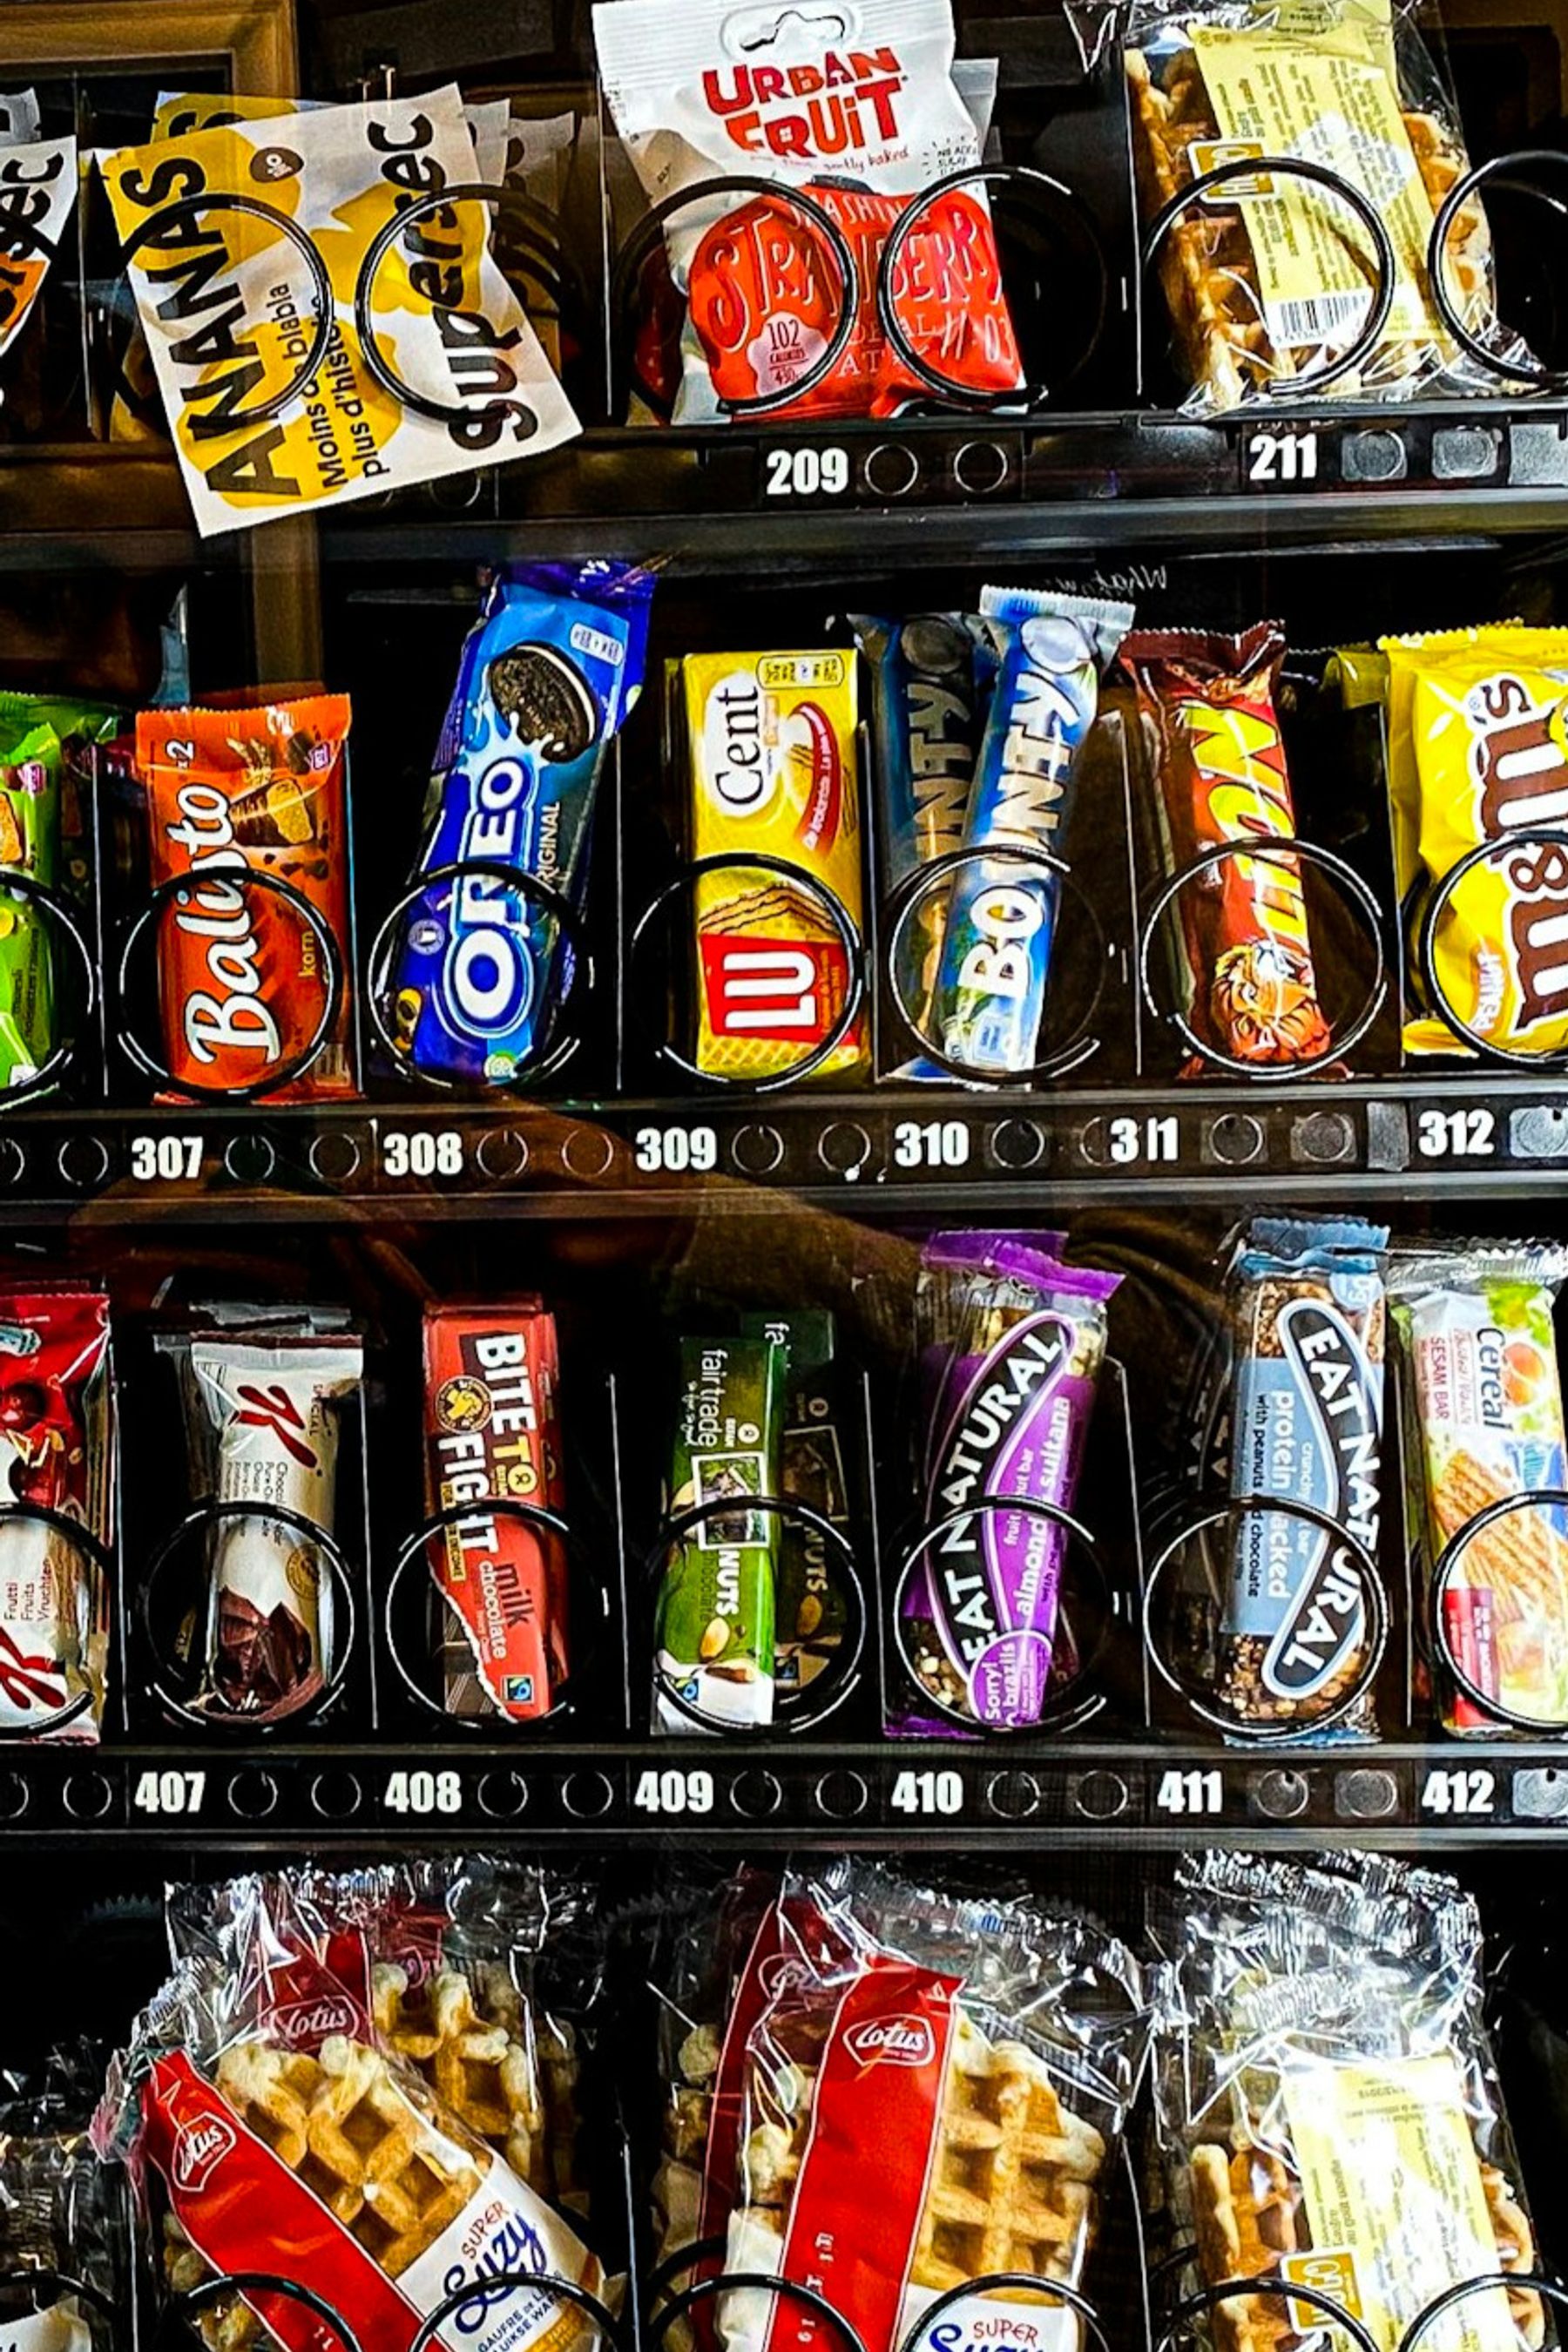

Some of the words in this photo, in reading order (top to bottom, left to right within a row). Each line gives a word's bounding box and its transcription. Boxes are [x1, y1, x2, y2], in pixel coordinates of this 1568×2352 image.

[702, 47, 902, 115] URBAN
[118, 157, 302, 497] ANANAS
[266, 283, 304, 359] blabla
[767, 319, 801, 350] 102
[308, 399, 348, 490] Moins
[350, 409, 390, 477] plus
[767, 449, 848, 495] 209
[1249, 435, 1317, 480] 211
[715, 686, 764, 806] Cent
[536, 801, 561, 885] RIGINAL
[453, 756, 524, 1021] OREO
[723, 950, 816, 1029] LU
[132, 1136, 203, 1179] 307
[383, 1132, 463, 1175] 308
[636, 1127, 717, 1171] 309
[895, 1122, 969, 1166] 310
[1110, 1118, 1179, 1162] 311
[1418, 1110, 1494, 1155] 312
[476, 1334, 537, 1436] BITE
[700, 1349, 728, 1384] fair
[1299, 1326, 1369, 1421] EAT
[1430, 1336, 1448, 1386] SESAM
[235, 1383, 320, 1471] K
[698, 1384, 721, 1449] trade
[1254, 1394, 1268, 1425] with
[1434, 1390, 1450, 1422] BAR
[940, 1333, 1064, 1555] NATURAL
[1251, 1429, 1267, 1489] peanuts
[1269, 1390, 1297, 1490] protein
[1017, 1516, 1049, 1617] almond
[1039, 1396, 1070, 1491] sultana
[715, 1548, 740, 1617] NUTS
[1248, 1523, 1264, 1598] chocolate
[1267, 1504, 1293, 1599] acked
[1280, 1434, 1382, 1677] NATURAL
[478, 1558, 507, 1660] chocolate
[496, 1562, 530, 1626] milk
[945, 1571, 997, 1665] EAT
[984, 1649, 1003, 1720] Sorry!
[1002, 1640, 1017, 1709] brazils
[134, 1772, 206, 1813] 407
[384, 1772, 462, 1813] 408
[634, 1772, 713, 1813] 409
[891, 1770, 963, 1815] 410
[1158, 1770, 1222, 1814] 411
[1423, 1770, 1493, 1814] 412
[285, 2003, 349, 2040] Lotus
[855, 2020, 925, 2051] Lotus
[461, 2200, 510, 2261] SUPER
[443, 2207, 549, 2330] Suzy
[973, 2317, 1038, 2348] SUPER
